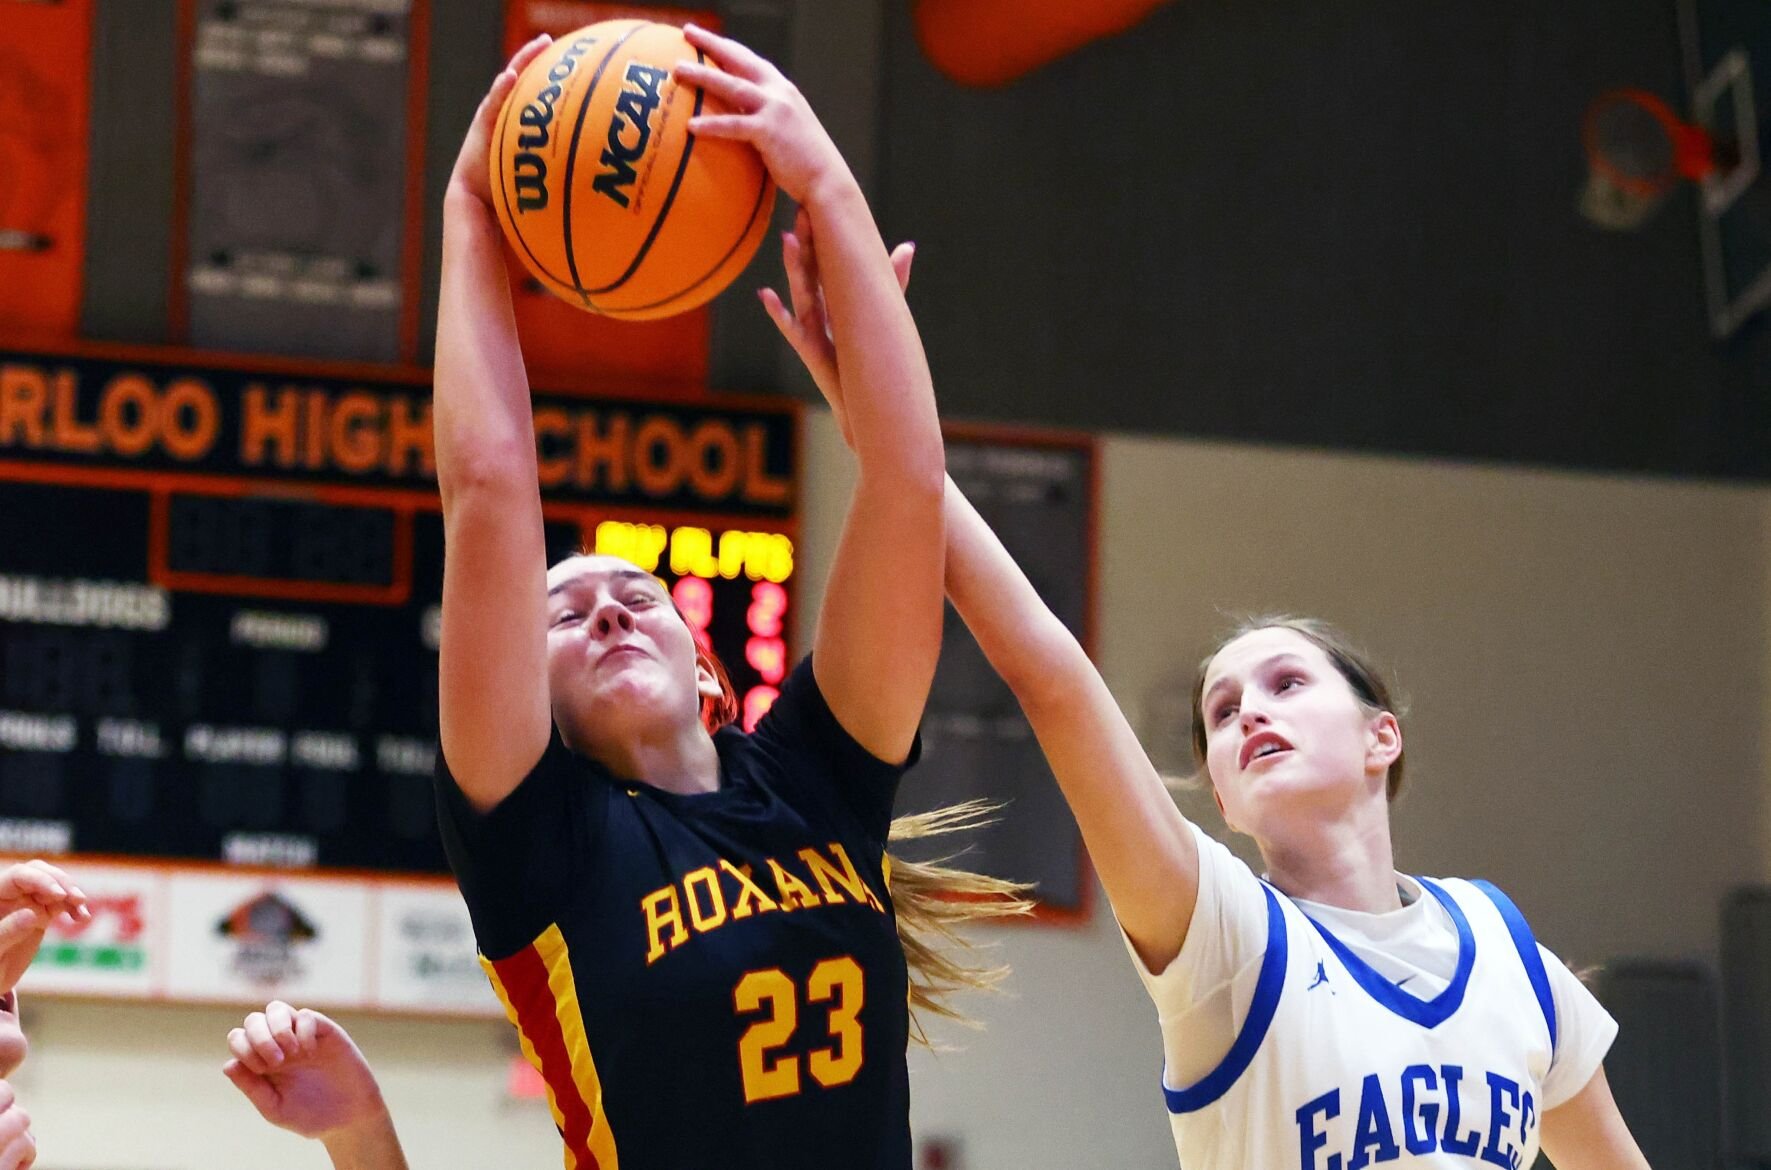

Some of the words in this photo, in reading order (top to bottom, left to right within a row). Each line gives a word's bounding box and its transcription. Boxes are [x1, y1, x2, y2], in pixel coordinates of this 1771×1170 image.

[514, 36, 597, 214] Wilson
[592, 63, 669, 209] NCAA
[240, 382, 439, 477] HIGH
[533, 405, 790, 500] CHOOL
[733, 954, 865, 1106] 23
